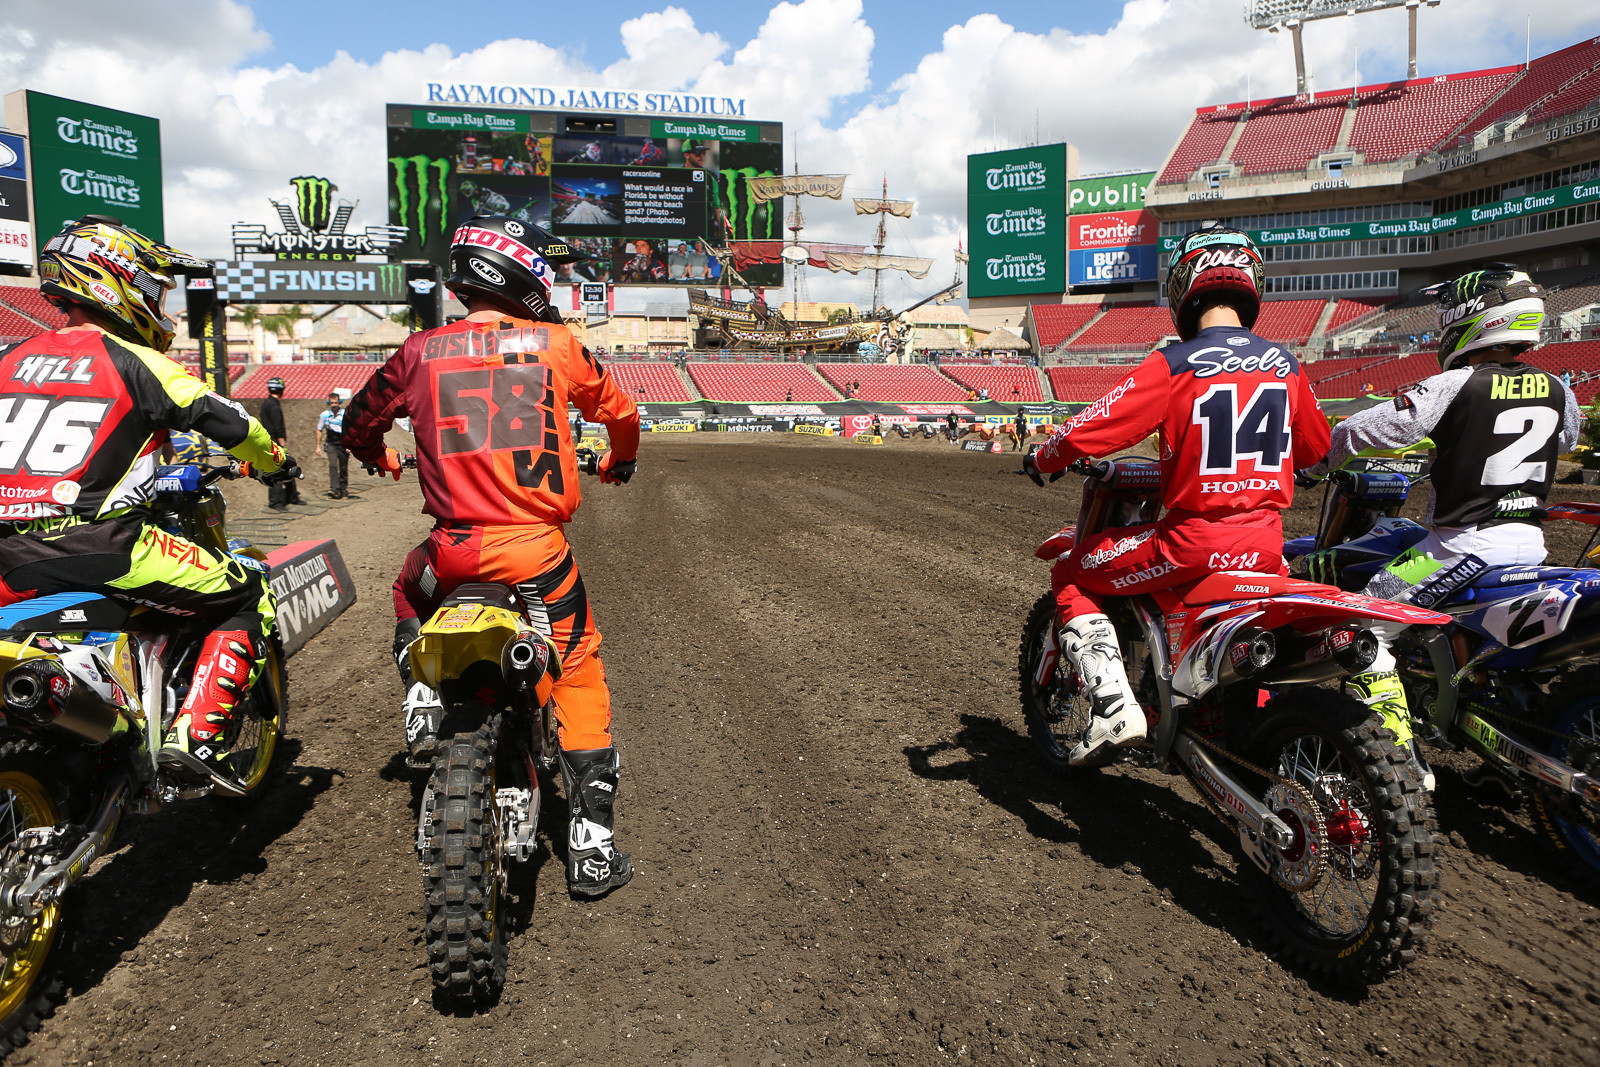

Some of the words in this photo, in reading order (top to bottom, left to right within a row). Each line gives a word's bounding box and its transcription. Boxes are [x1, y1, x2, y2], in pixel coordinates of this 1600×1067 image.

[426, 82, 556, 106] RAYMOND
[560, 89, 639, 110] JAMES
[645, 93, 746, 116] STADIUM
[83, 118, 114, 134] Tampa
[115, 125, 132, 138] Bay
[426, 112, 462, 127] Tampa
[463, 114, 484, 127] Bay
[484, 114, 516, 126] Times
[56, 116, 138, 154] Times
[664, 122, 698, 137] Tampa
[698, 124, 717, 137] Bay
[718, 125, 746, 137] Times
[1546, 130, 1559, 142] 40
[1563, 117, 1600, 138] ALSTO
[1005, 163, 1028, 173] Tampa
[1028, 161, 1042, 170] Bay
[1450, 151, 1478, 168] LYNCH
[60, 168, 140, 203] Times
[86, 169, 117, 184] Tampa
[118, 174, 136, 186] Bay
[986, 166, 1046, 192] Times
[1312, 178, 1350, 190] GRUDEN
[624, 183, 644, 192] What
[644, 184, 664, 192] would
[624, 192, 648, 200] Florida
[648, 192, 658, 200] be
[659, 192, 684, 200] without
[1189, 190, 1224, 200] GLAZER
[646, 208, 670, 216] (Photo
[1005, 208, 1028, 218] Tampa
[1028, 206, 1042, 216] Bay
[1471, 206, 1503, 222] Tampa
[1504, 202, 1523, 215] Bay
[1524, 194, 1556, 210] Times
[624, 216, 686, 225] @shepherdphotos)
[986, 212, 1046, 236] Times
[1369, 222, 1407, 236] Tampa
[1408, 220, 1430, 233] Bay
[1432, 216, 1458, 231] Times
[1080, 222, 1146, 240] Frontier
[1260, 230, 1296, 244] Tampa
[1296, 228, 1317, 240] Bay
[1318, 226, 1350, 238] Times
[260, 233, 373, 250] MONSTER
[1080, 236, 1142, 246] COMMUNICATIONS
[278, 252, 356, 261] ENERGY
[545, 245, 570, 256] JGR
[1005, 254, 1028, 264] Tampa
[1028, 252, 1042, 262] Bay
[1094, 251, 1130, 266] BUD
[474, 262, 500, 282] HJC
[986, 257, 1046, 282] Times
[1086, 264, 1137, 280] LIGHT
[269, 270, 376, 292] FINISH
[93, 284, 115, 302] BELL
[1441, 295, 1485, 327] 100%
[1485, 318, 1508, 329] BELL
[1508, 312, 1544, 330] 2
[204, 340, 216, 368] THOR
[1188, 347, 1291, 378] Seely
[1490, 373, 1550, 400] WEBB
[436, 364, 547, 457] 58
[728, 424, 774, 432] MONSTER
[988, 416, 1050, 424] SUKI
[0, 396, 110, 476] 46
[798, 425, 826, 435] SUZUKI
[1192, 382, 1292, 476] 14
[1481, 406, 1560, 486] 2
[1366, 459, 1422, 473] Kawasaki
[1200, 478, 1282, 494] HONDA
[0, 502, 72, 518] UZUKI
[1498, 496, 1538, 511] THOR
[1081, 552, 1098, 570] Troy
[1096, 548, 1116, 564] Lee
[270, 574, 290, 600] CKY
[284, 554, 328, 592] MOUNTAIN
[1110, 560, 1178, 589] HONDA
[1428, 560, 1482, 593] YAMAHA
[1509, 571, 1538, 582] YAMAHA
[1233, 584, 1270, 594] HONDA
[60, 609, 88, 624] JGR
[1507, 590, 1551, 648] 2
[588, 780, 614, 792] FOX
[1200, 768, 1226, 797] ENTHAL
